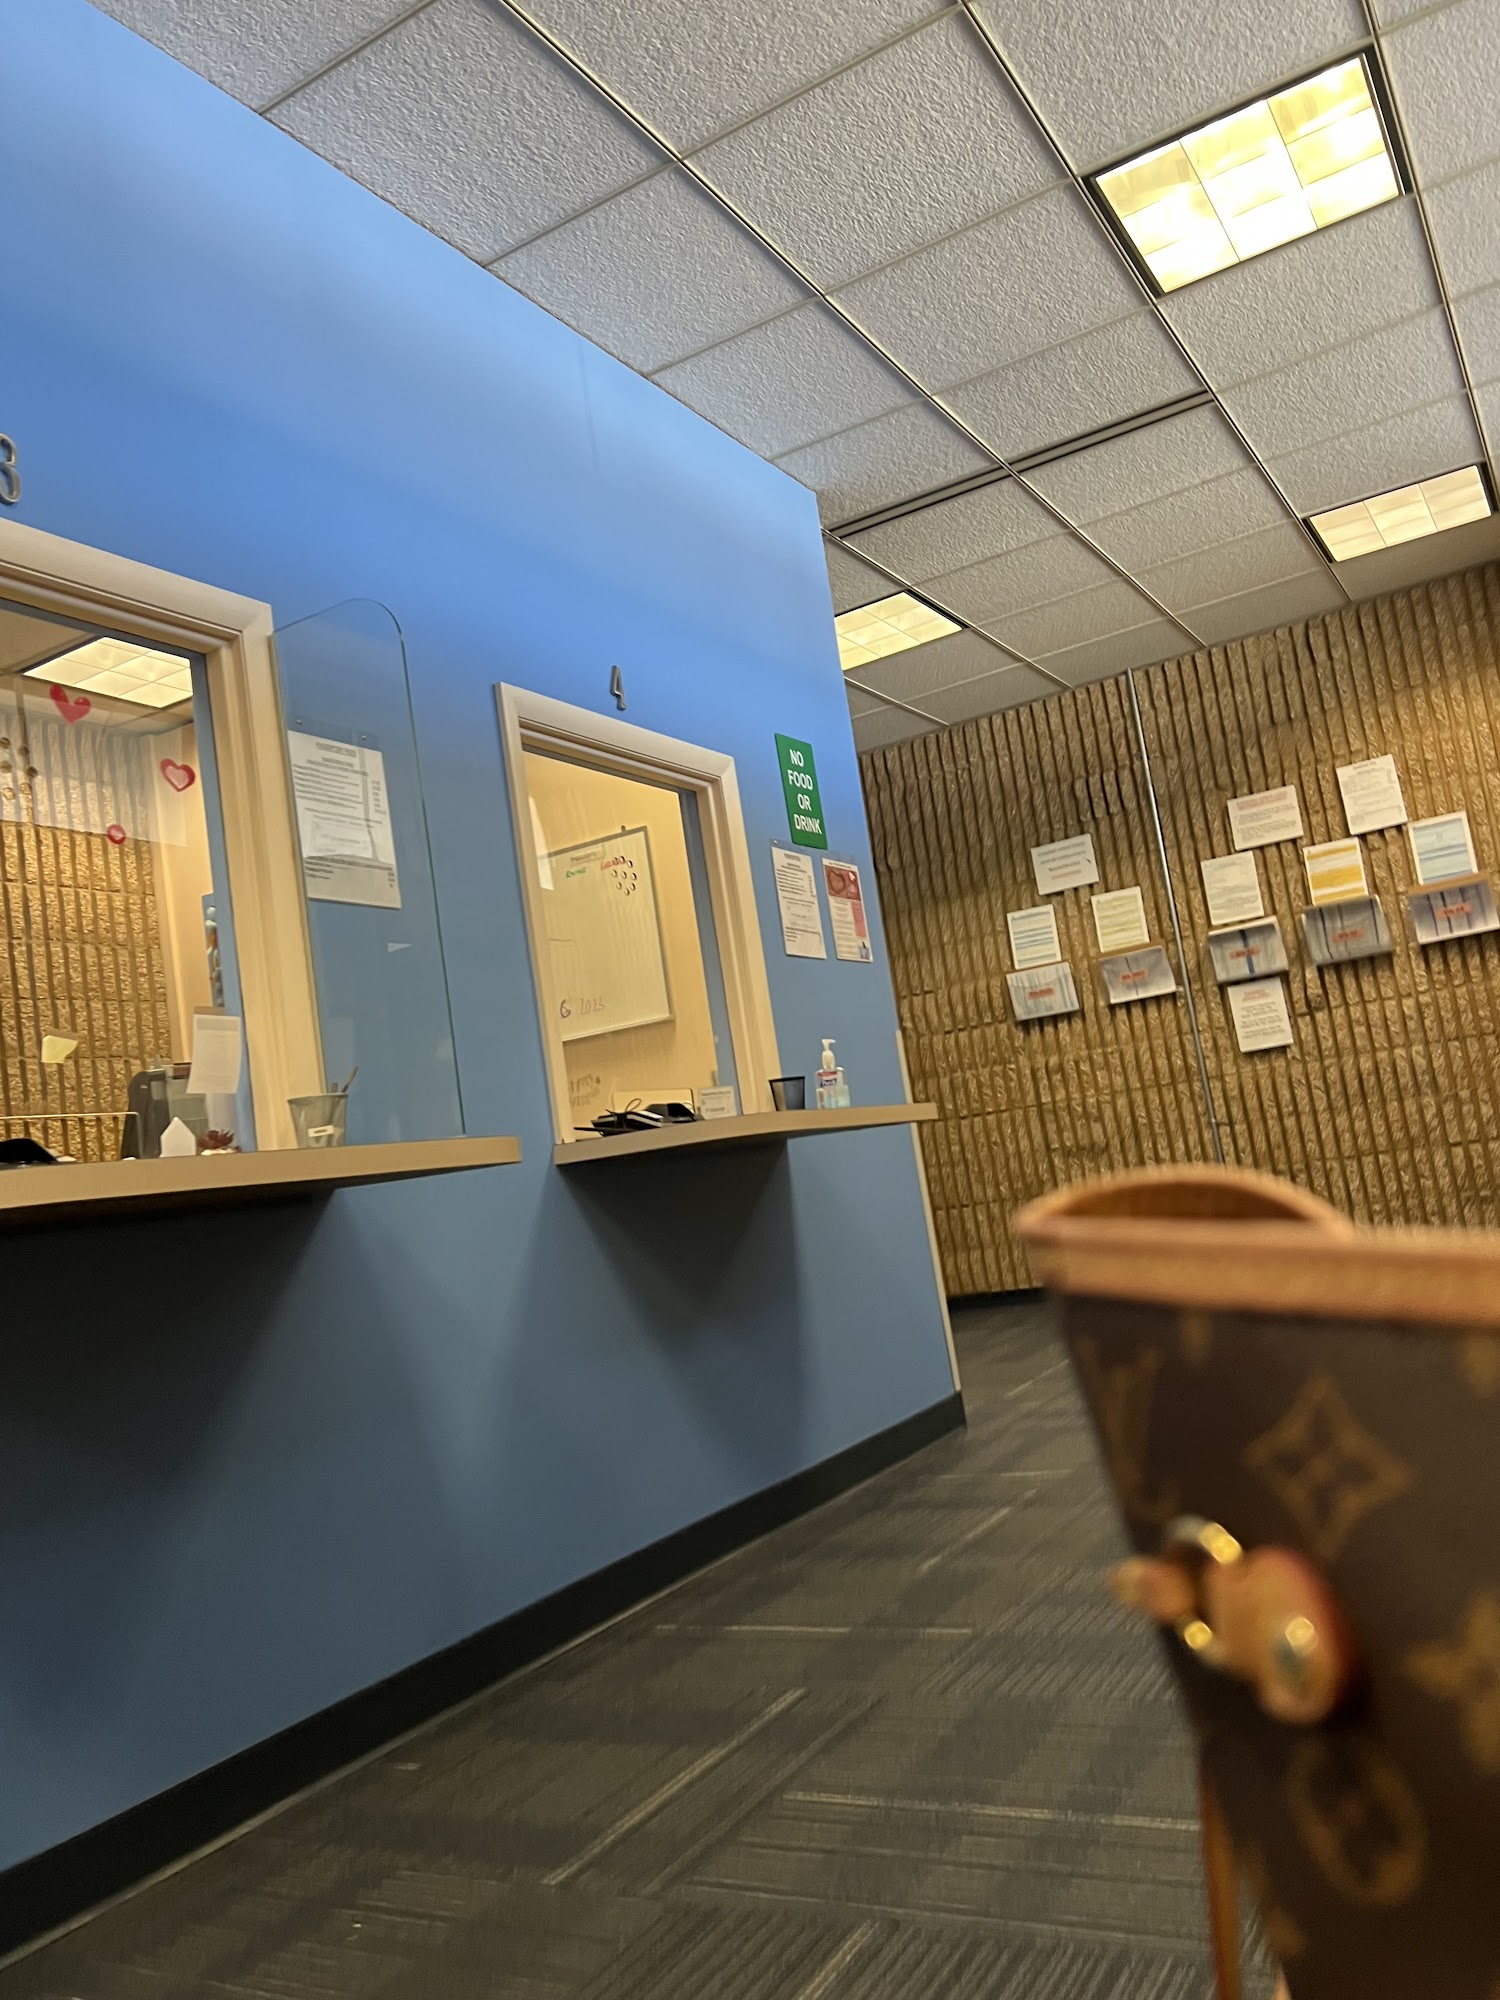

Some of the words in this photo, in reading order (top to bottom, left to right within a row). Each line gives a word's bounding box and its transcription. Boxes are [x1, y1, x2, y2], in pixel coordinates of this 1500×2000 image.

[609, 664, 627, 711] 4
[789, 748, 804, 767] NO
[787, 769, 813, 790] FOOD
[797, 793, 812, 811] OR
[793, 813, 823, 835] DRINK
